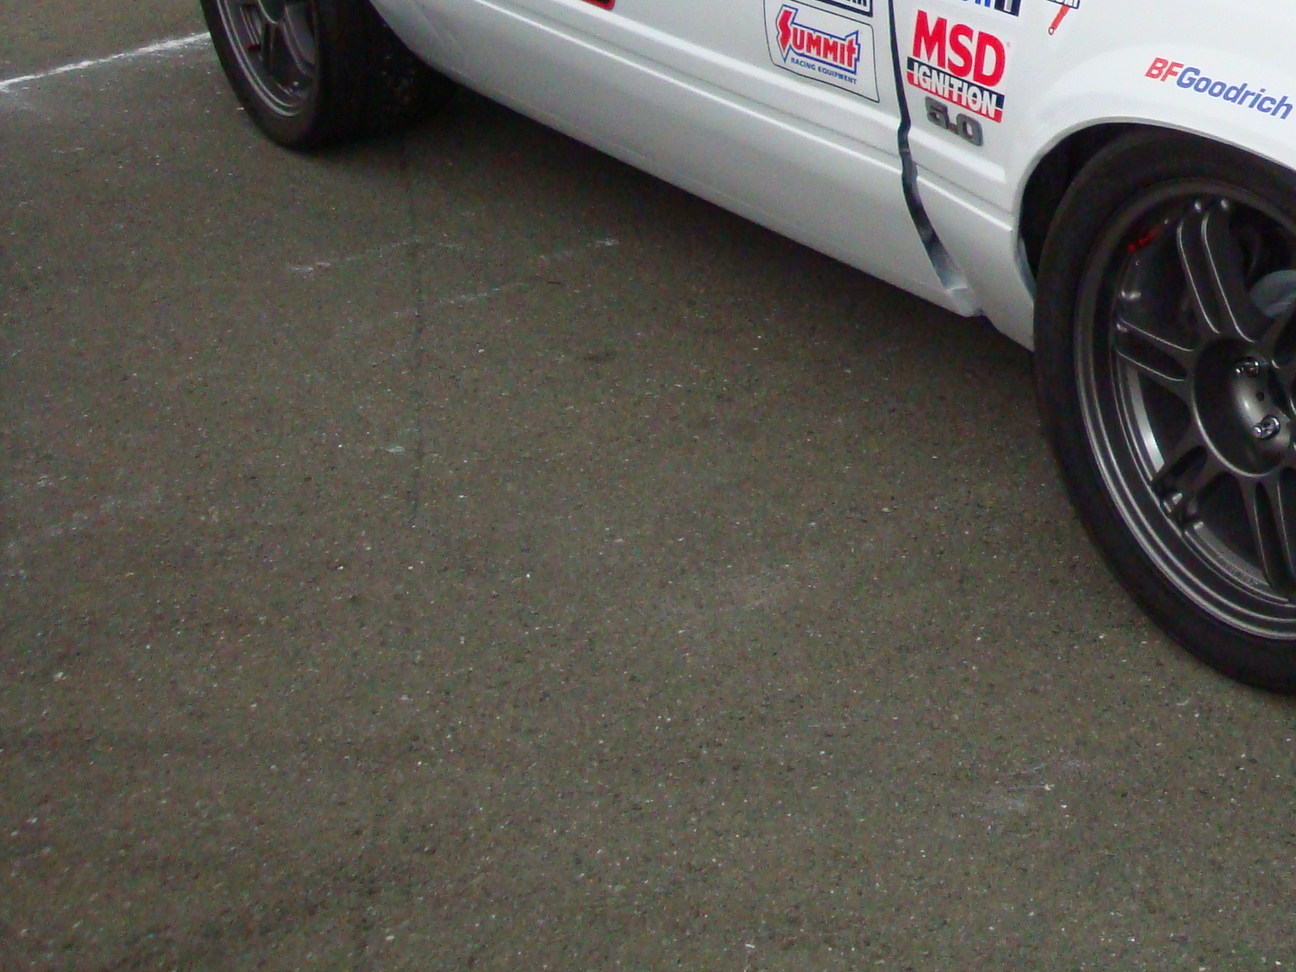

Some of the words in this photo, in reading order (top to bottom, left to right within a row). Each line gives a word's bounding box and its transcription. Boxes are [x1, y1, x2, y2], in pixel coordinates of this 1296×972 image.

[790, 57, 816, 71] RACING
[817, 66, 857, 85] EQUIPMENT
[912, 9, 1006, 87] MSD
[912, 61, 997, 119] IGNITION
[1145, 57, 1293, 120] BFGoodrich
[925, 95, 984, 147] 5.0
